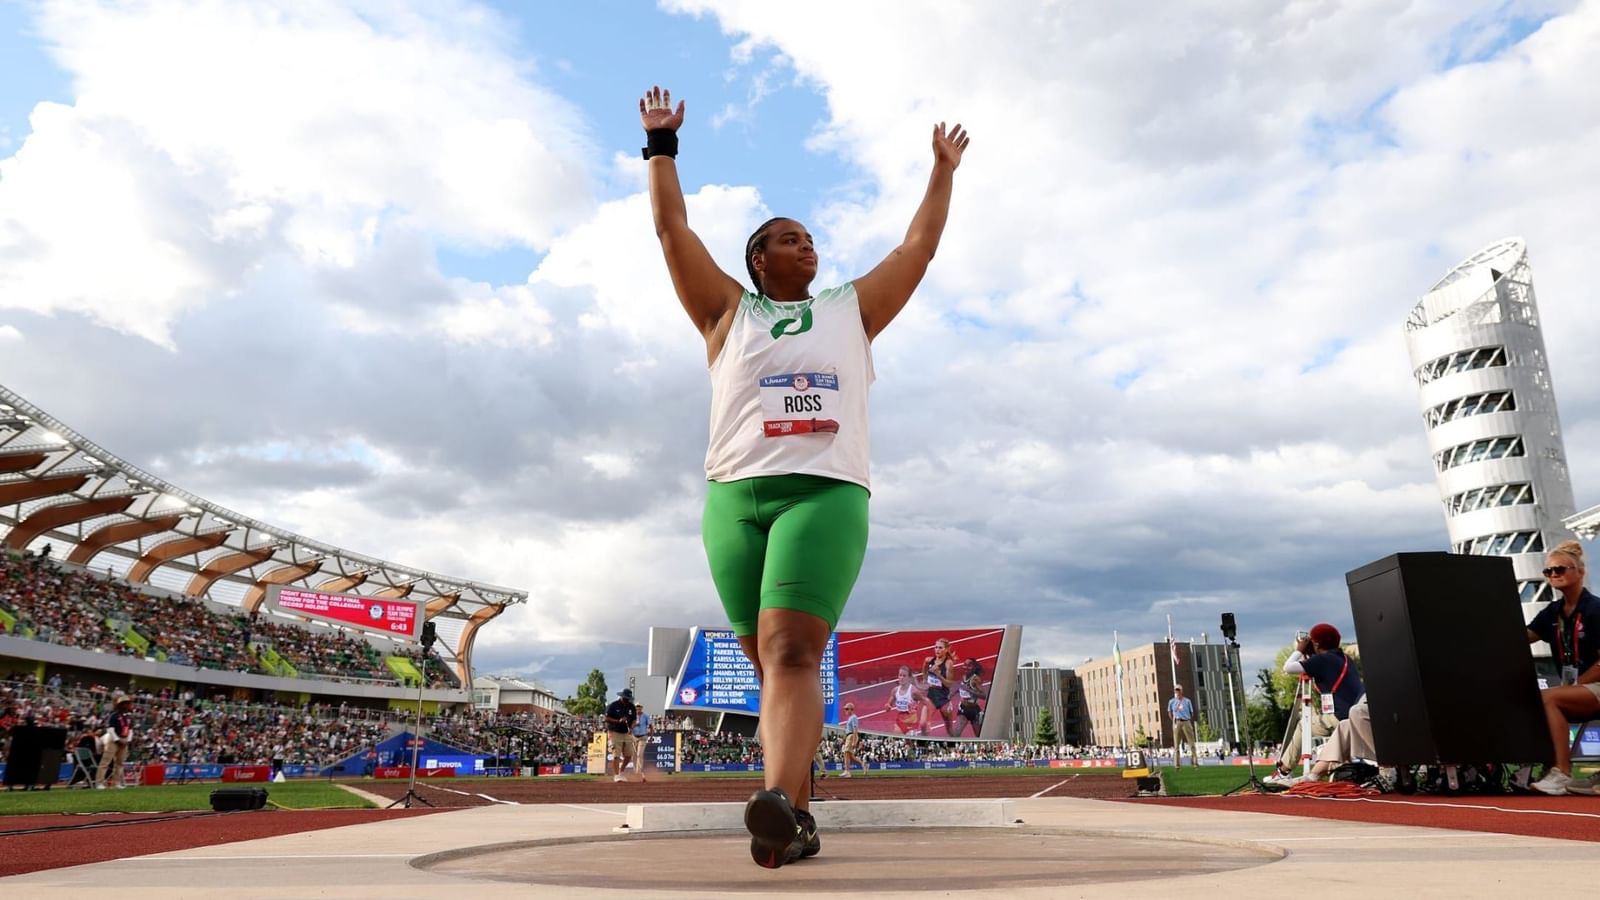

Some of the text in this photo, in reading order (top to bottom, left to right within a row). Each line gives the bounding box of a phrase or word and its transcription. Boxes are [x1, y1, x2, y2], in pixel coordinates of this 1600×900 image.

[784, 394, 822, 413] ROSS
[281, 589, 300, 597] RIGHT
[300, 591, 318, 599] HERE,
[279, 600, 329, 611] RECORD HOLDER
[329, 601, 365, 609] COLLEGIATE
[1127, 751, 1140, 766] 18
